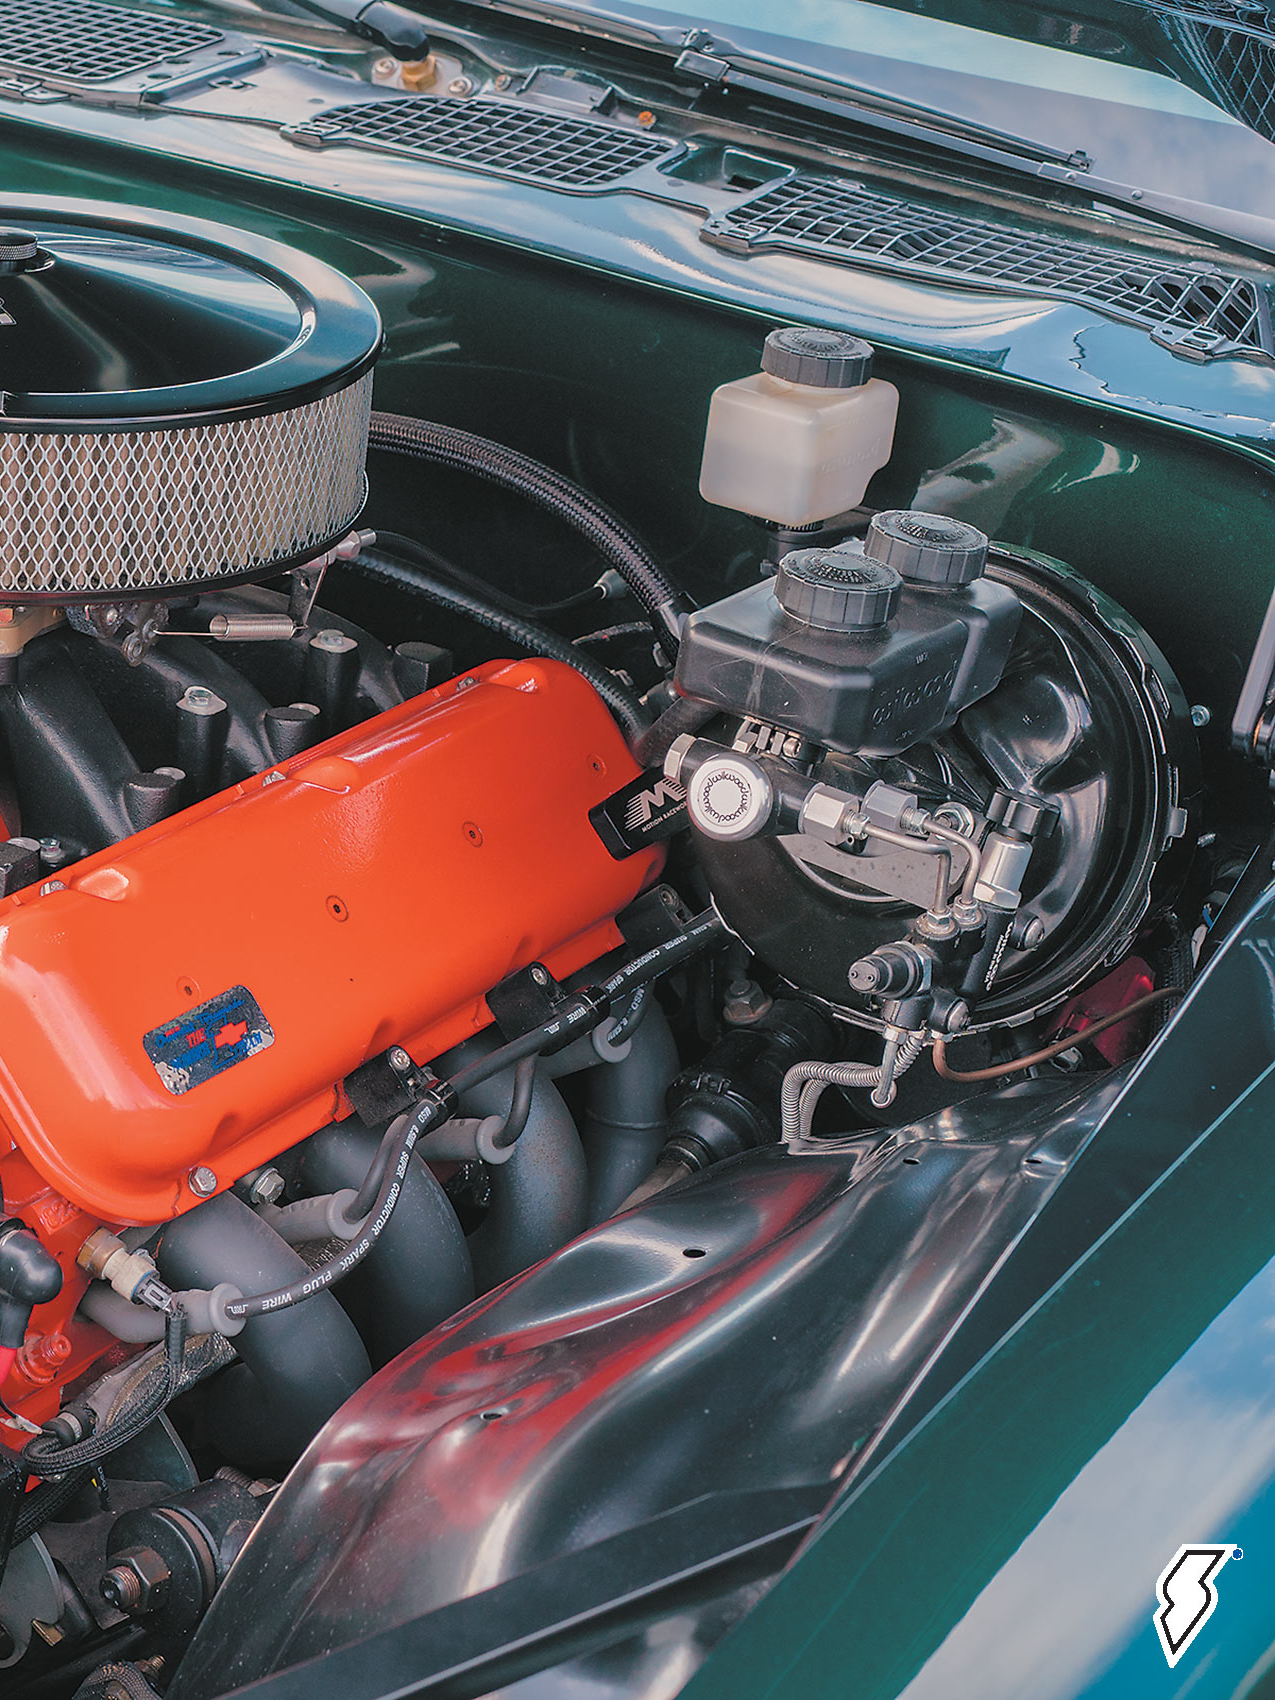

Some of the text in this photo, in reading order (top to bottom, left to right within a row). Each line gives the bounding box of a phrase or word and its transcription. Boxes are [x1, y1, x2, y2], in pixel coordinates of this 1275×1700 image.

[641, 816, 663, 832] MOTION
[624, 949, 661, 976] CONDUCTOR
[566, 1006, 587, 1023] WIRE
[186, 1027, 207, 1048] THE
[418, 1106, 432, 1124] MSD
[396, 1151, 410, 1180] SUPER
[371, 1182, 401, 1236] CONDUCTOR
[339, 1238, 370, 1271] SPARK
[302, 1269, 333, 1295] PLUG
[261, 1292, 293, 1311] WIRE
